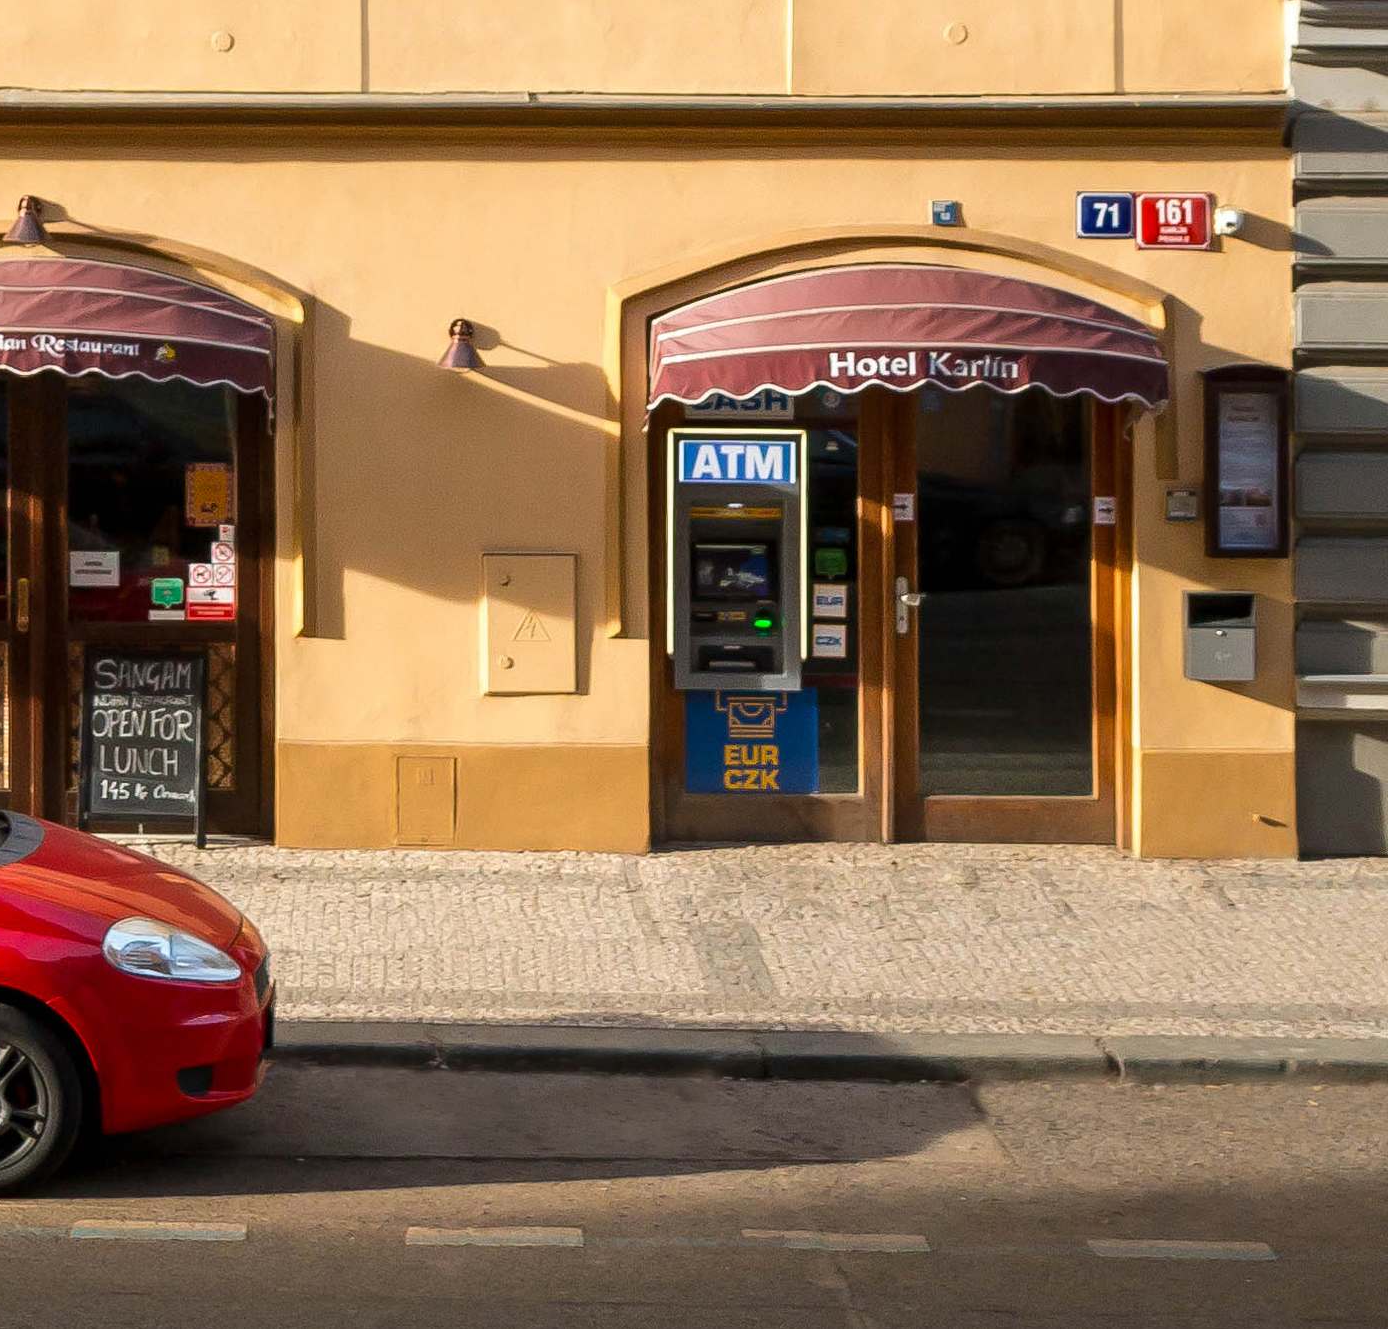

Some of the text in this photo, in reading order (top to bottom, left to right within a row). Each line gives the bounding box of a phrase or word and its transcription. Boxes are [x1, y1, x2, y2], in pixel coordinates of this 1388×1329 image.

[1092, 202, 1120, 228] 71
[1155, 198, 1193, 225] 161
[32, 334, 140, 358] Restaurant
[828, 351, 917, 378] Hotel
[691, 444, 784, 480] ATM
[94, 658, 193, 692] SANGAM
[92, 709, 148, 738] OPEN
[99, 744, 179, 776] LUNCH
[723, 744, 780, 766] EUR
[100, 779, 131, 800] 145
[723, 769, 781, 790] CZK
